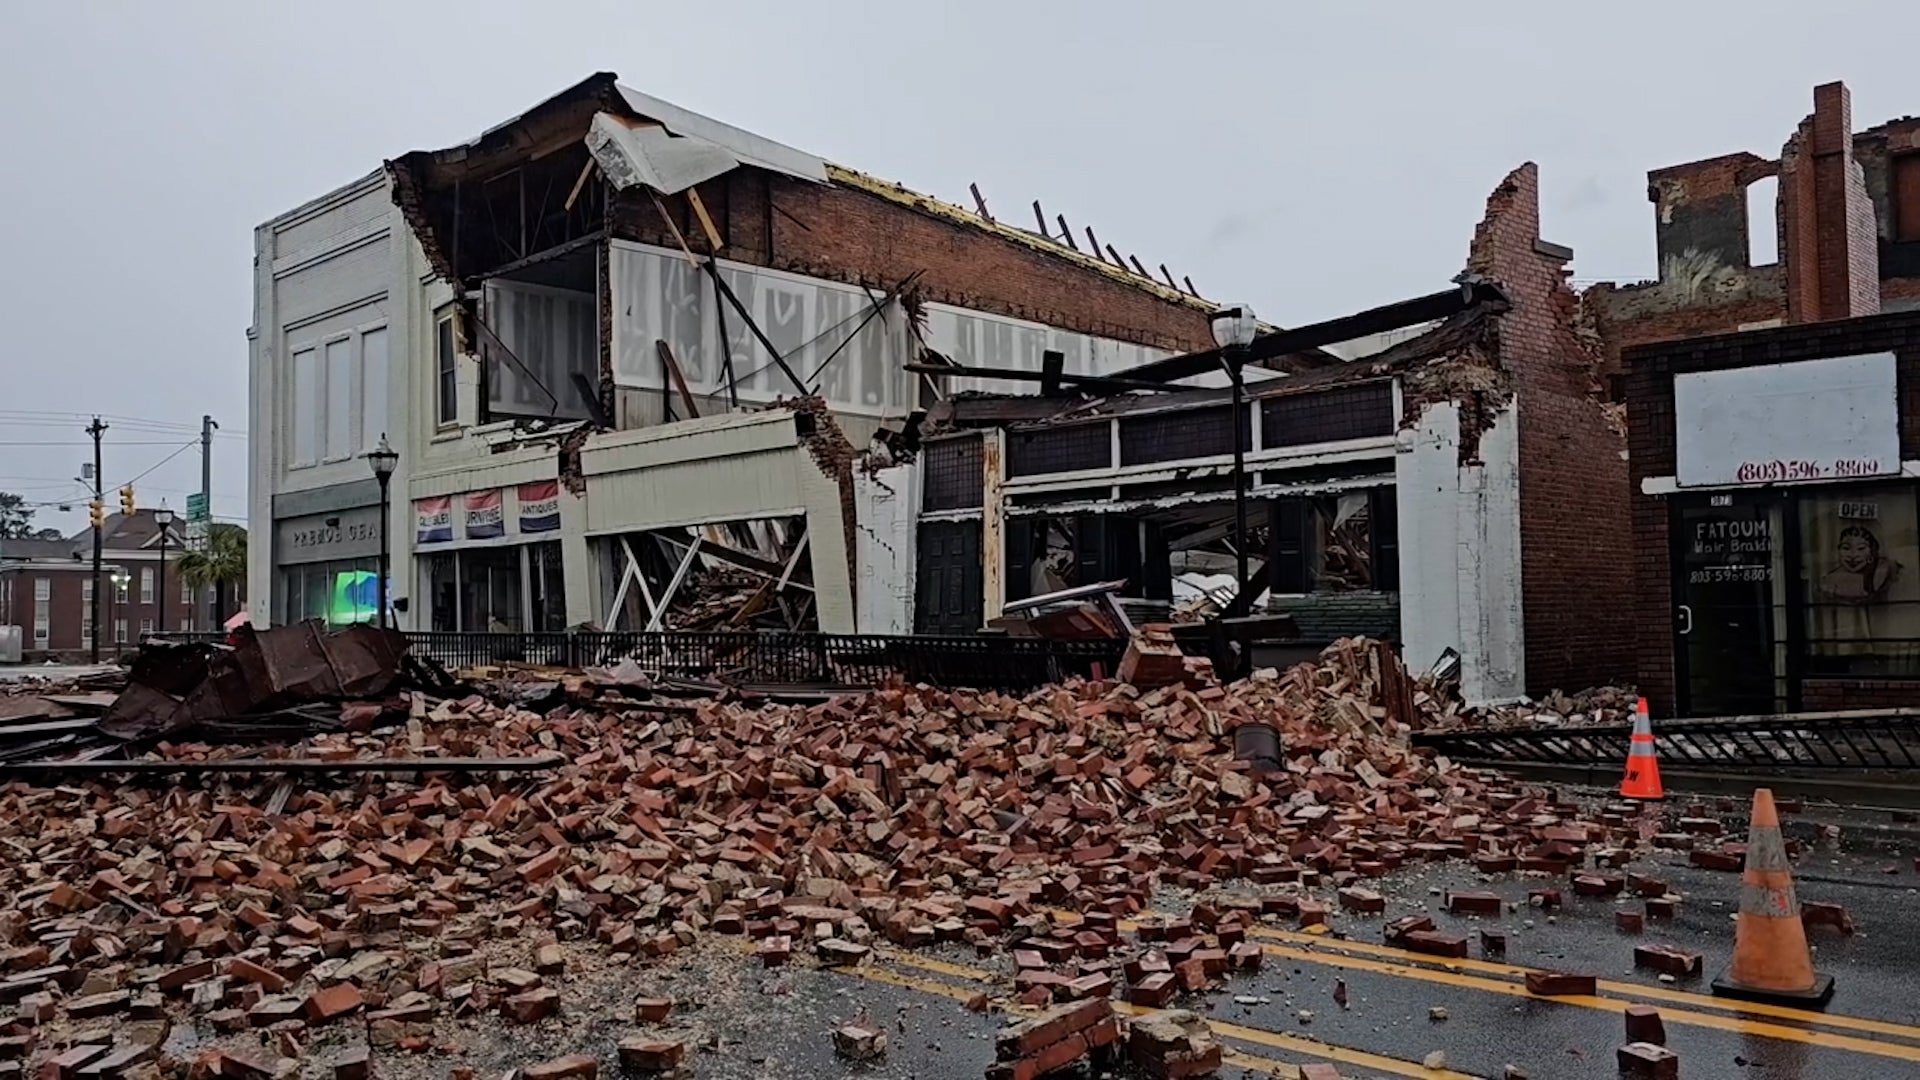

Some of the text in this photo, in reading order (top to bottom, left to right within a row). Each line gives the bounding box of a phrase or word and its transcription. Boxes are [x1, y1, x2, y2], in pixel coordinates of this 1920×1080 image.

[522, 501, 558, 515] ANTIQUES
[1841, 503, 1875, 517] OPEN
[1697, 520, 1773, 539] FATOUM
